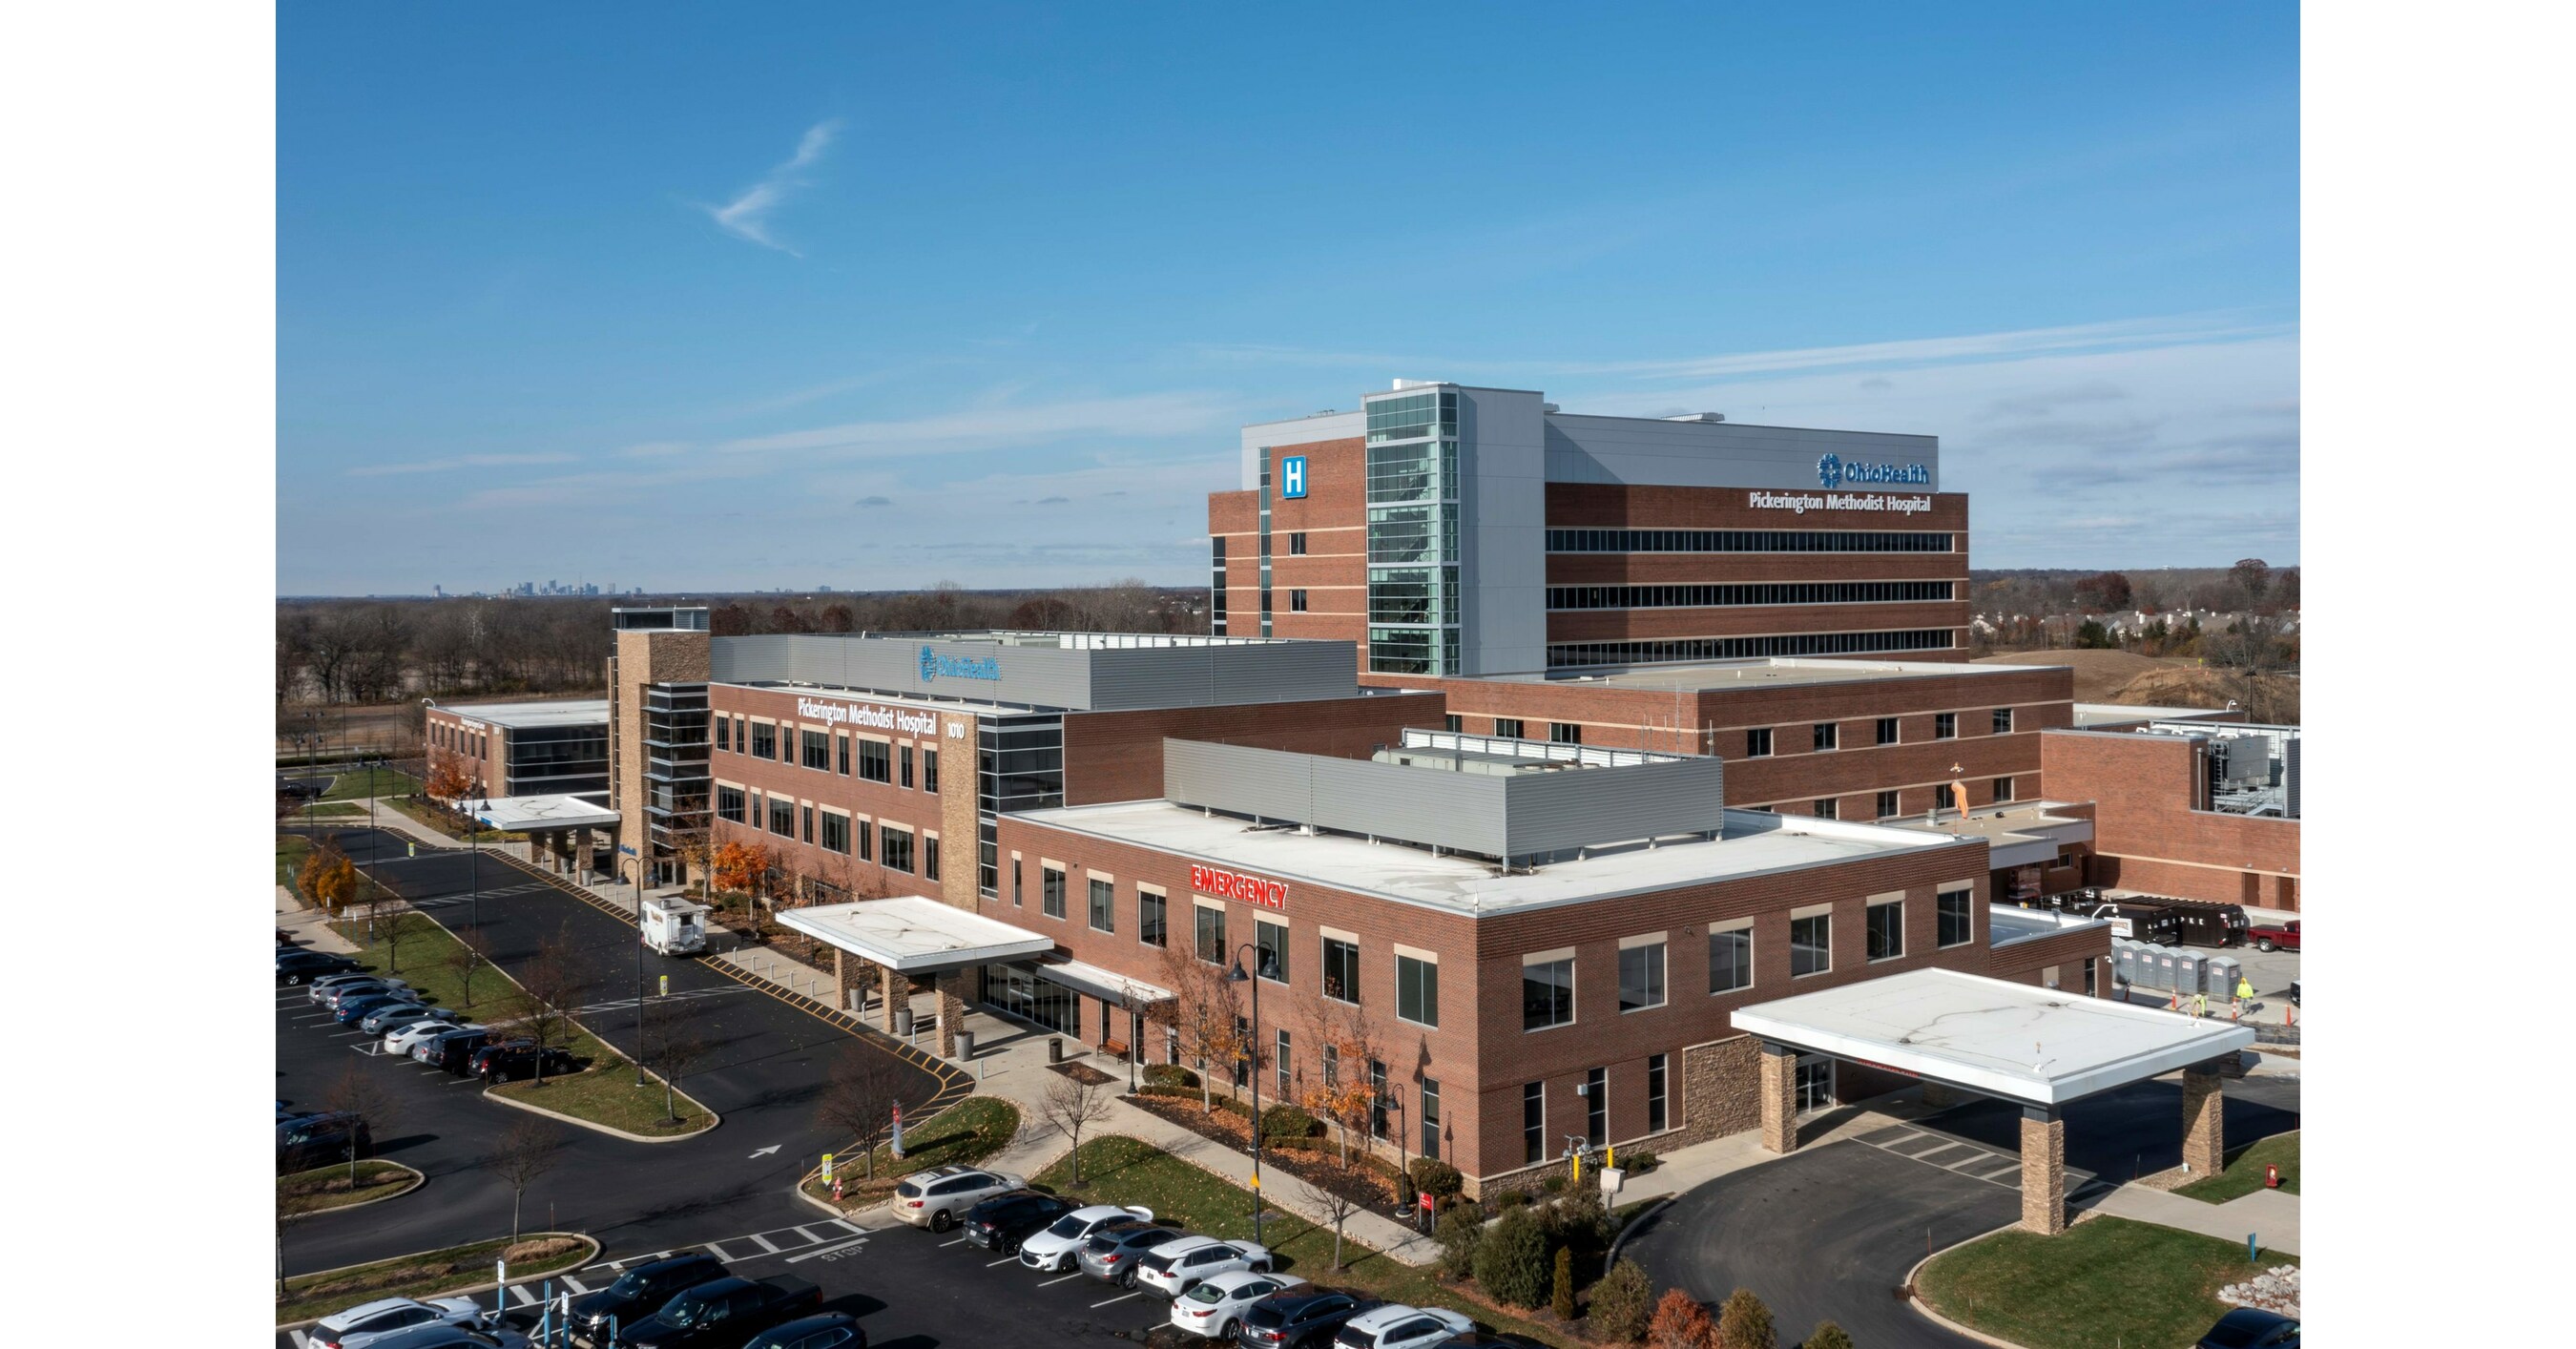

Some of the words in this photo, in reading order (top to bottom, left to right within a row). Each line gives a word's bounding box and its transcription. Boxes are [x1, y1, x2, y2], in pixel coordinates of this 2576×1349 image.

[1286, 461, 1302, 493] H
[1843, 462, 1929, 485] OhioHealth
[1750, 492, 1823, 515] Pickerington
[1826, 494, 1885, 512] Methodist
[1886, 496, 1931, 516] Hospital
[936, 654, 1002, 680] OhioHealth
[798, 697, 847, 727] Pickerington
[848, 704, 895, 730] Methodist
[896, 711, 937, 738] Hospital
[947, 722, 965, 739] 1010
[1191, 863, 1289, 910] EMERGENCY
[821, 1246, 863, 1262] STOP
